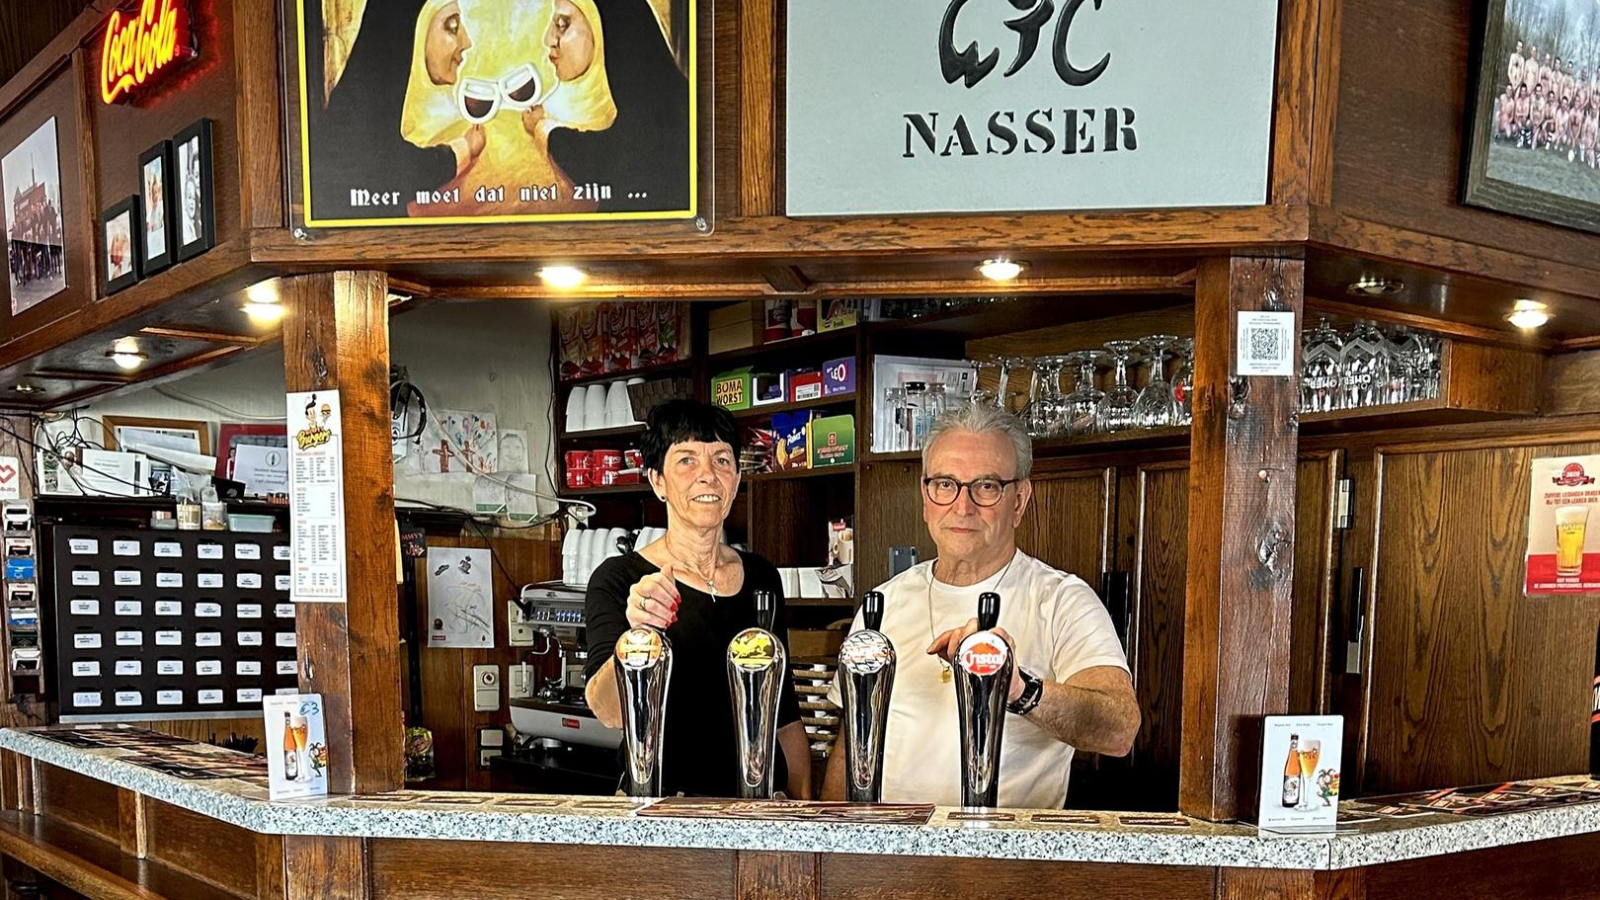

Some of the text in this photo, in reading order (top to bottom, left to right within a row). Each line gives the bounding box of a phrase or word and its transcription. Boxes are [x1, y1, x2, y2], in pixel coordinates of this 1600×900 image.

[902, 107, 1138, 158] NASSER
[350, 189, 400, 206] Meer
[573, 183, 611, 202] zijn
[716, 378, 743, 394] BOMA
[717, 391, 743, 405] WORST
[961, 649, 1006, 668] Cristal
